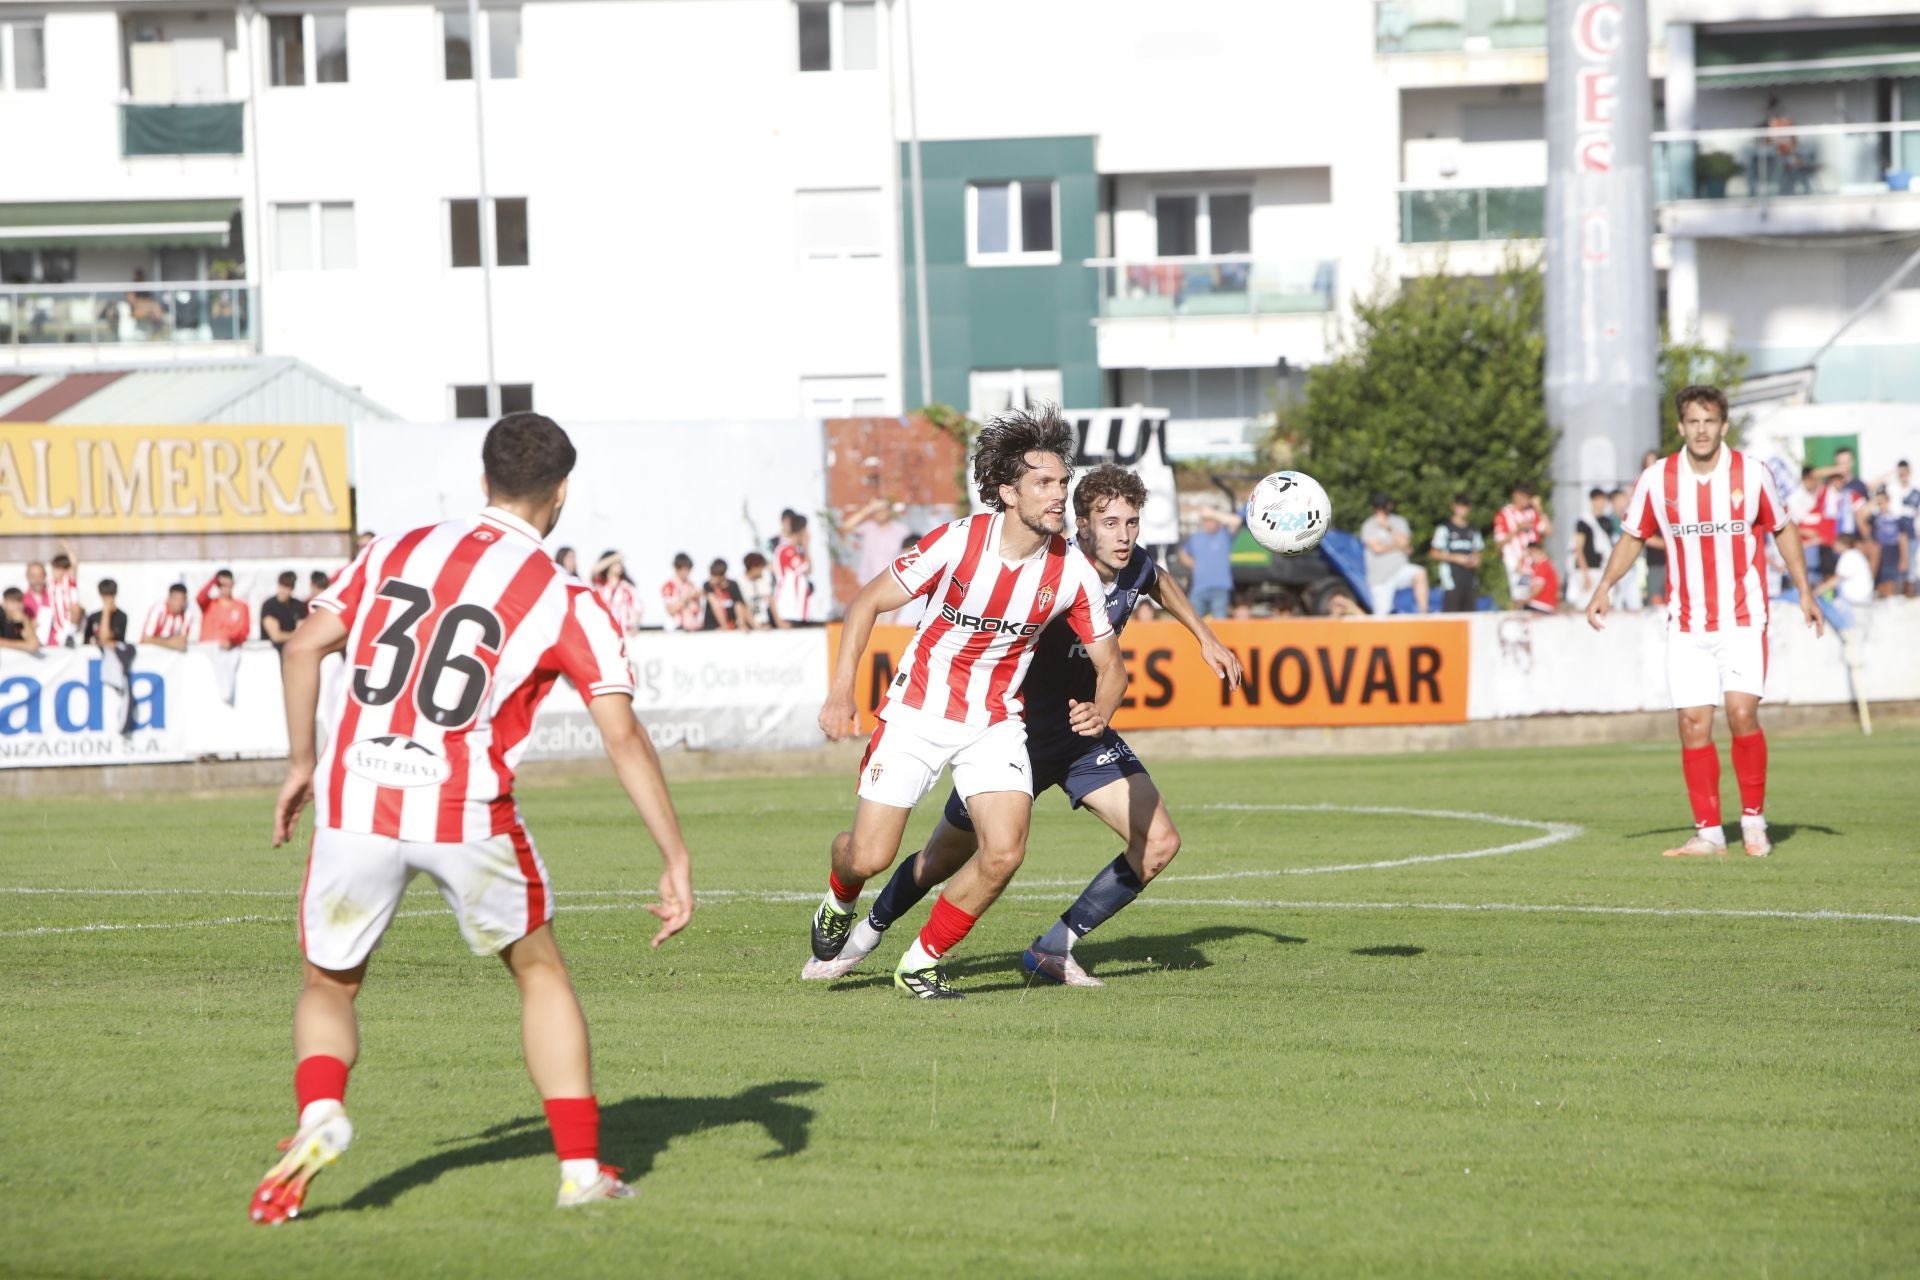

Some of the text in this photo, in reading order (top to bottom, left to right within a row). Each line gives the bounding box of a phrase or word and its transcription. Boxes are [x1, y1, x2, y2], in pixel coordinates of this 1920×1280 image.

[0, 438, 338, 518] ALIMERKA
[1671, 521, 1745, 537] SIROKO
[941, 602, 1040, 636] SIROKO
[351, 577, 504, 730] 36
[1220, 647, 1443, 707] NOVAR
